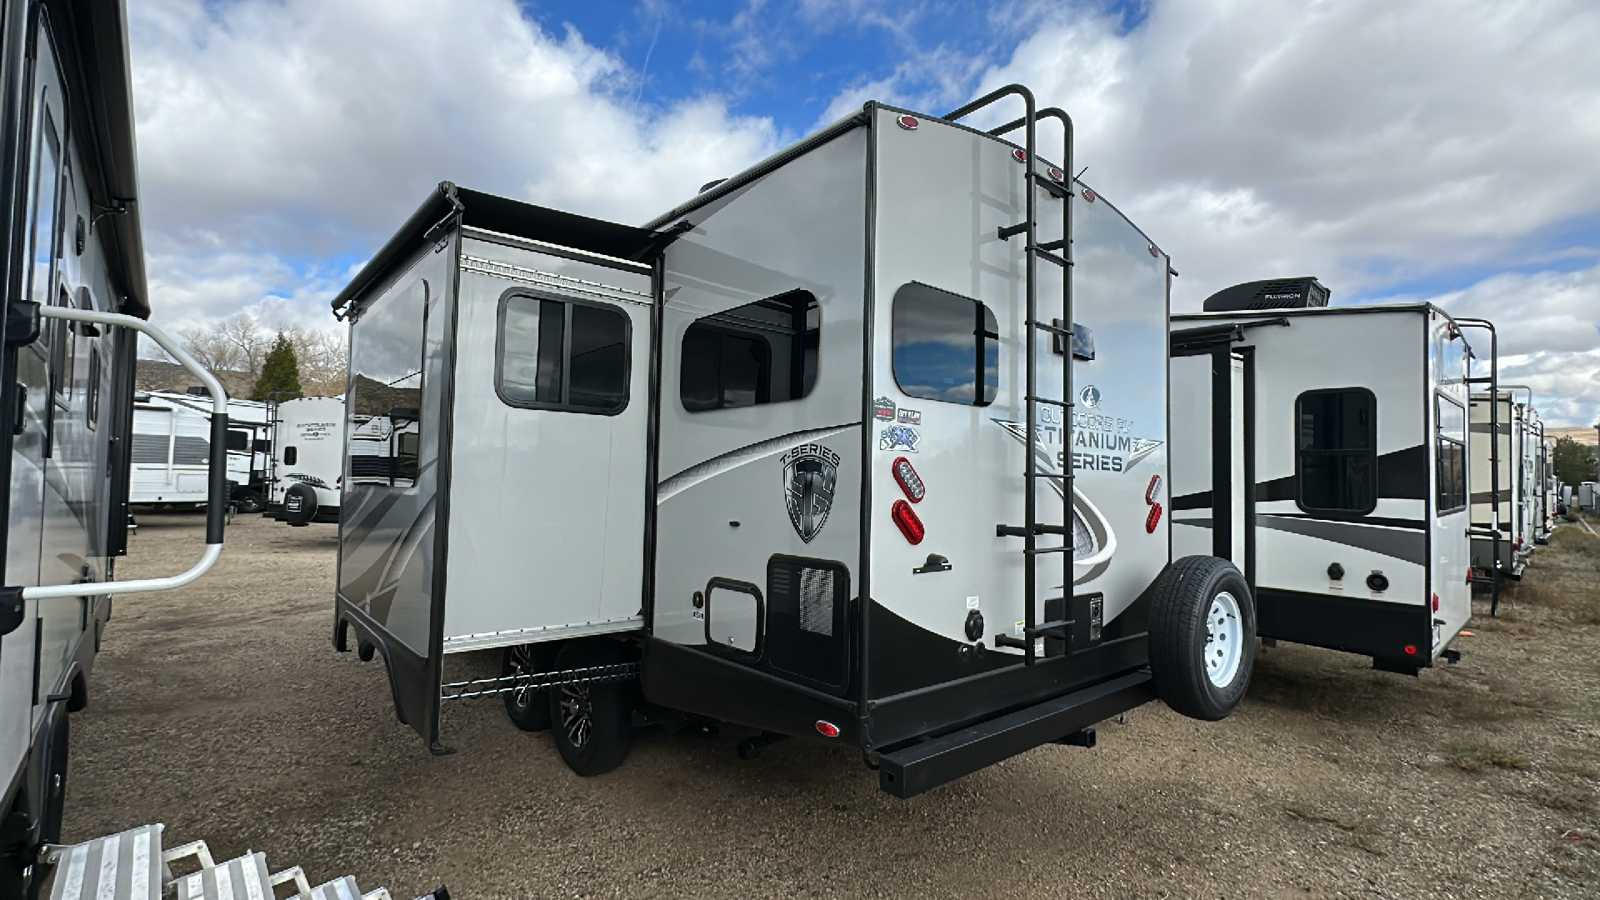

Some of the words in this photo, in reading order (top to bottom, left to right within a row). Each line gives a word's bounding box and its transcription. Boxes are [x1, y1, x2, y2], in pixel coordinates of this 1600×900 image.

[1041, 406, 1113, 433] OUOORS
[1044, 425, 1131, 452] TIANIUM
[780, 444, 841, 467] T-SERIES
[1056, 451, 1123, 472] SERIES
